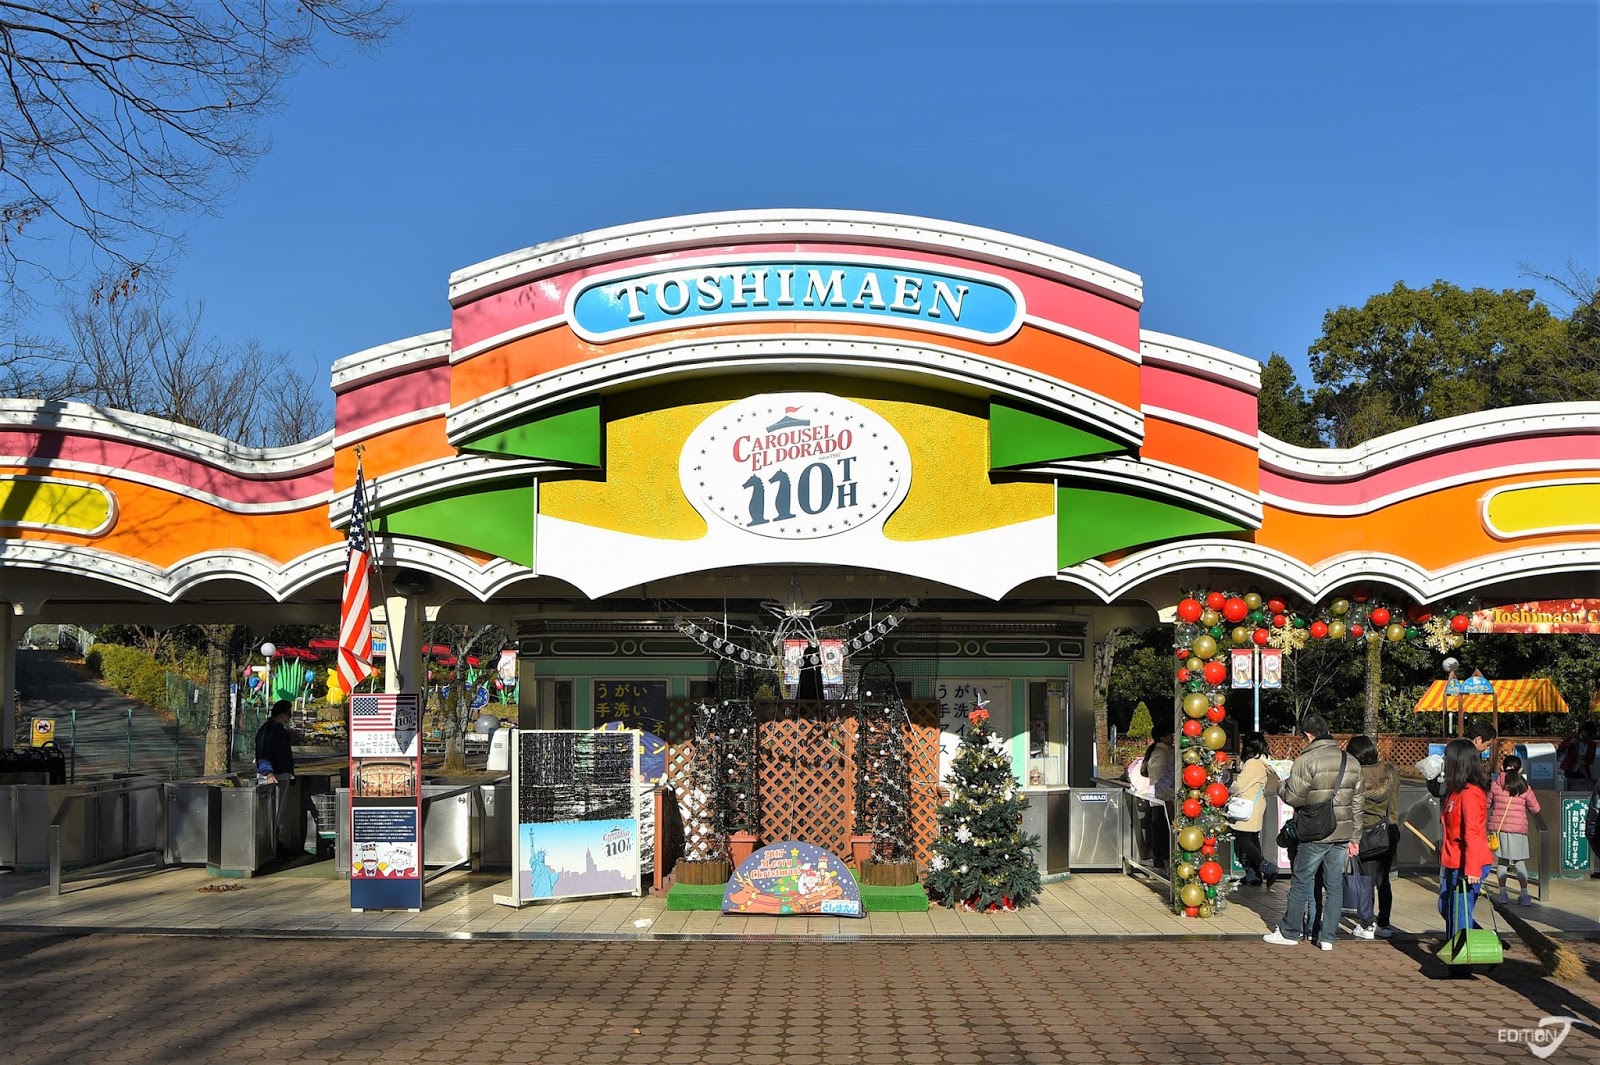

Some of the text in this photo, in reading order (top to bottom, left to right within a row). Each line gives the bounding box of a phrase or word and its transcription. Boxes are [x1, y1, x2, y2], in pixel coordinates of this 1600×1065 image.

[616, 268, 970, 322] TOSHIMAEN
[733, 425, 834, 462] CAROUSEL
[1491, 608, 1585, 623] Toshimaen
[597, 684, 648, 698] うがい
[938, 684, 987, 698] うがい
[595, 702, 648, 717] 手洗い
[764, 848, 785, 859] 2017
[758, 858, 793, 869] Merry
[822, 903, 858, 913] としまえん
